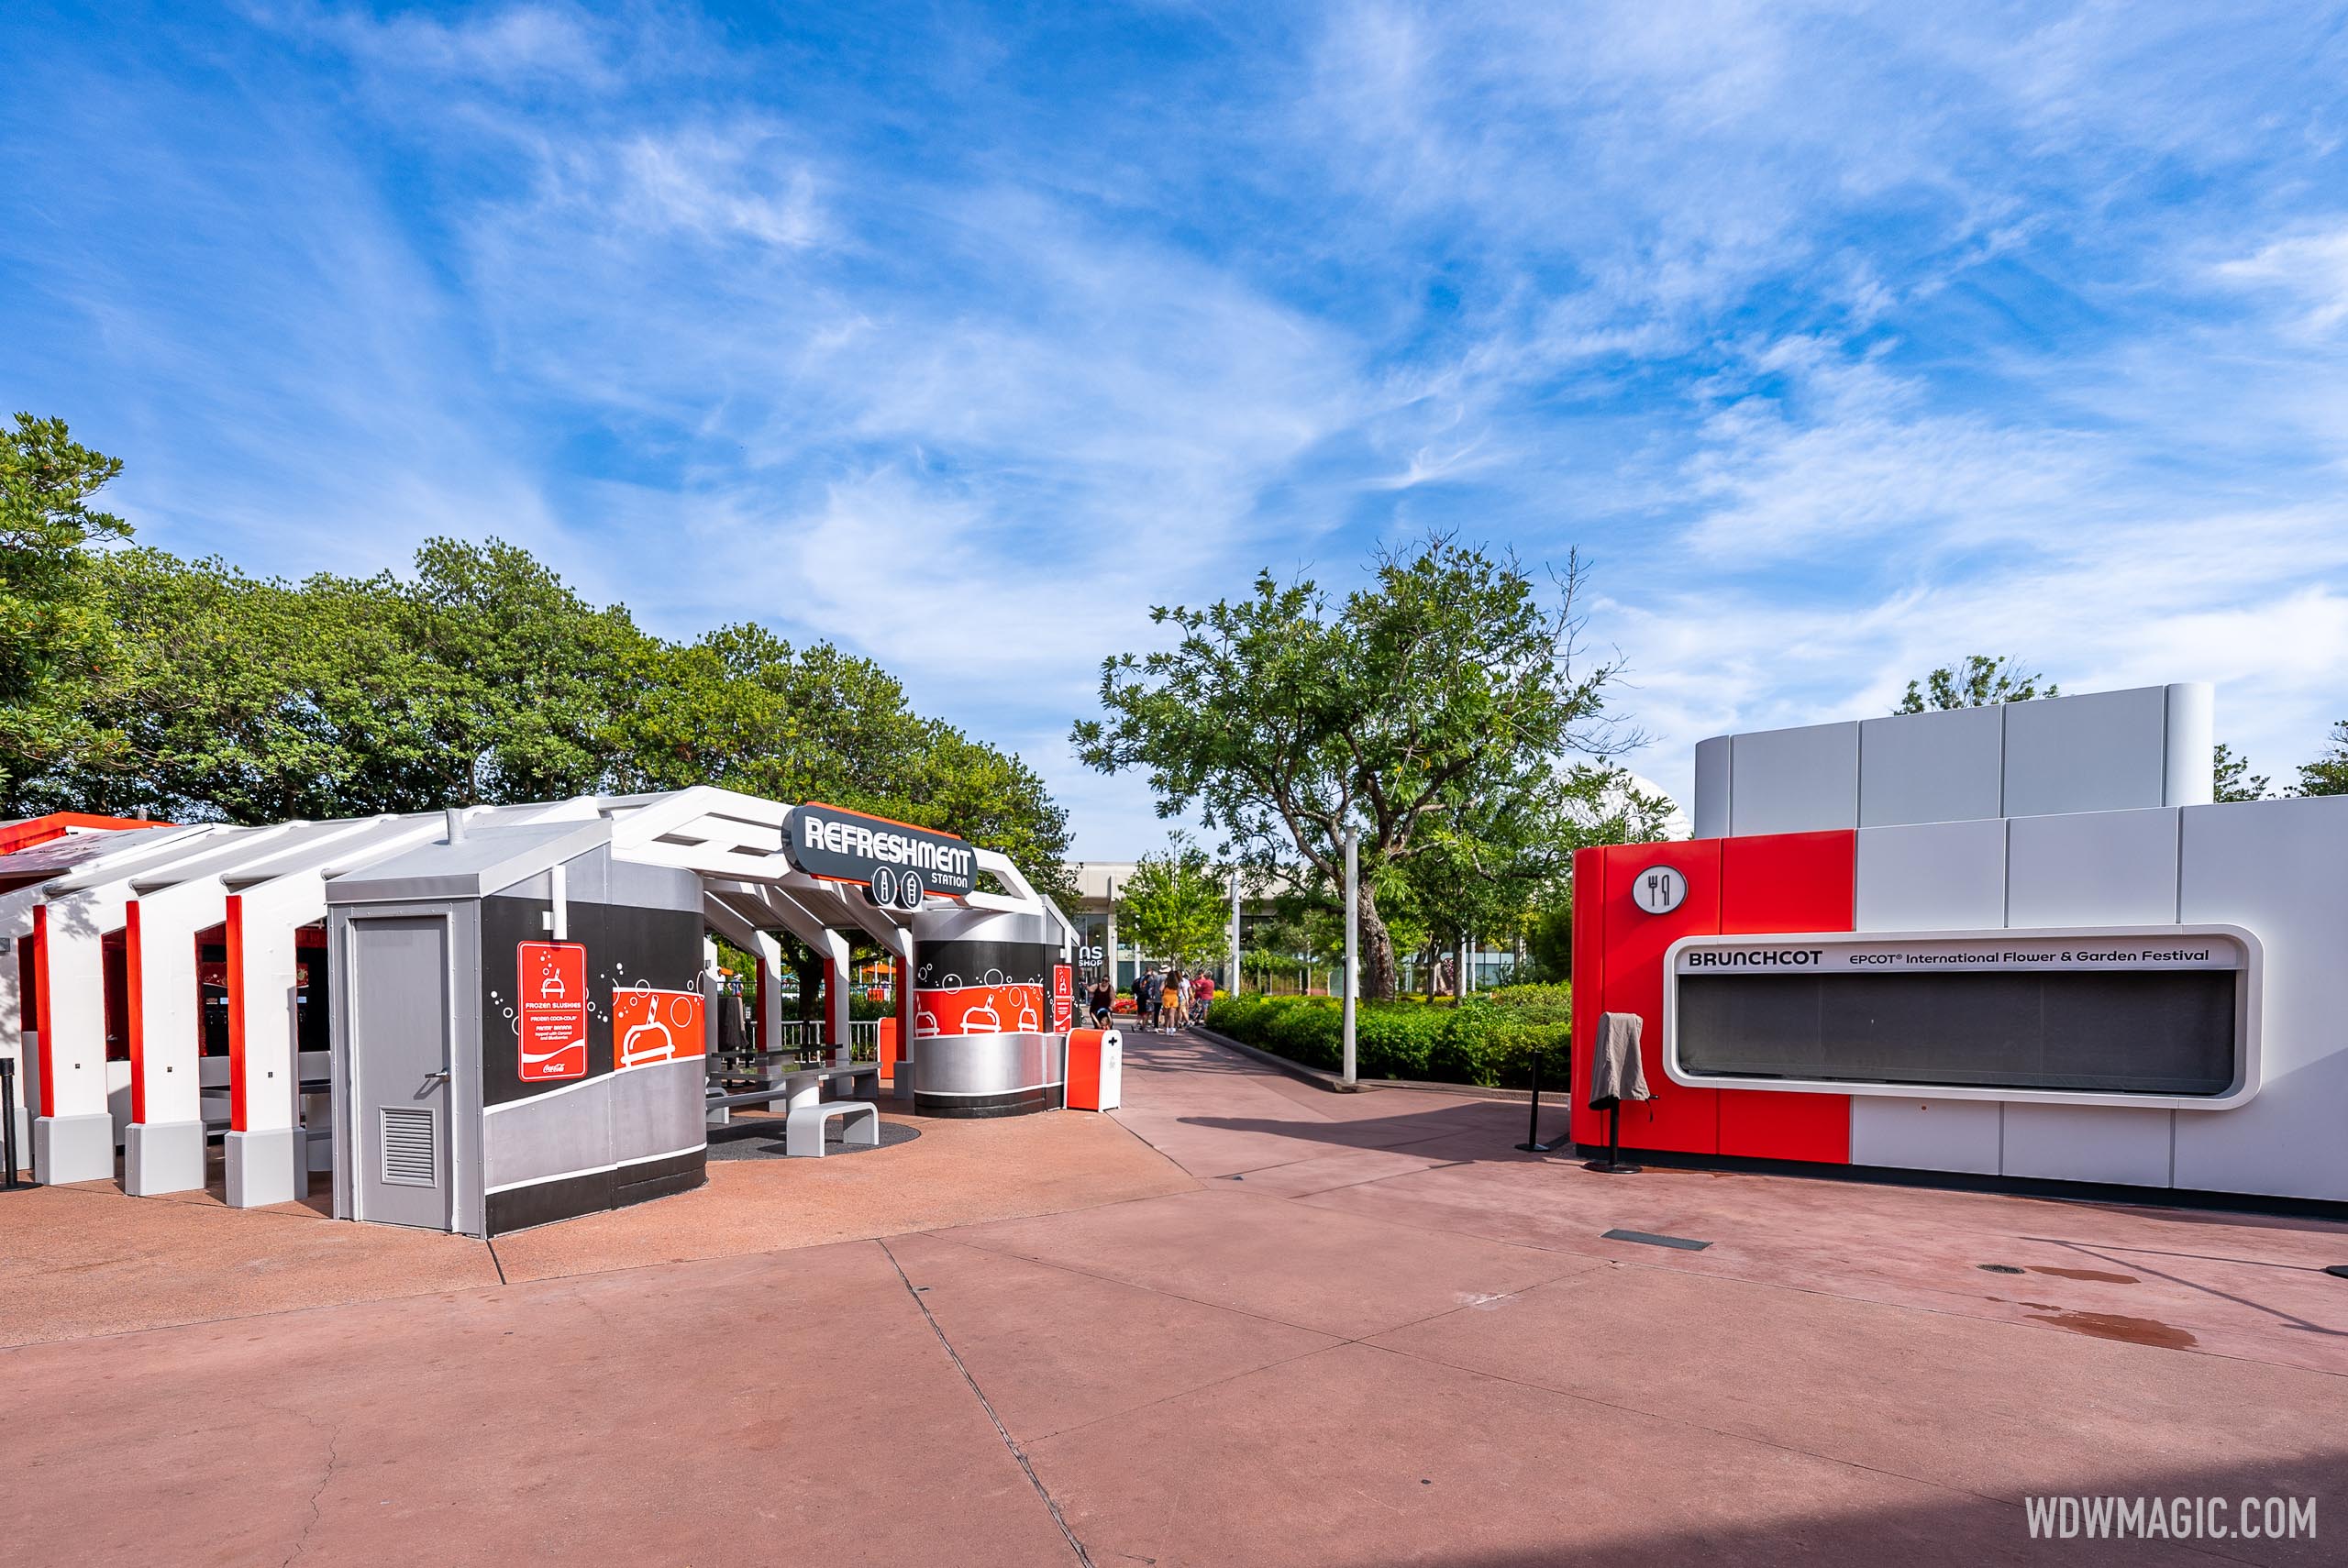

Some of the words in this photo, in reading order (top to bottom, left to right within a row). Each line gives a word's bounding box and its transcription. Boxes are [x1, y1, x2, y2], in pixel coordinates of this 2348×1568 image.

[804, 815, 971, 876] REFRESHMENT
[931, 872, 969, 889] STATION
[1689, 950, 1823, 966] BRUNCHCOT
[1906, 952, 1999, 964] International
[2003, 951, 2056, 963] Flower
[2060, 951, 2072, 962] &
[2076, 950, 2137, 962] Garden
[2142, 949, 2210, 961] Festival
